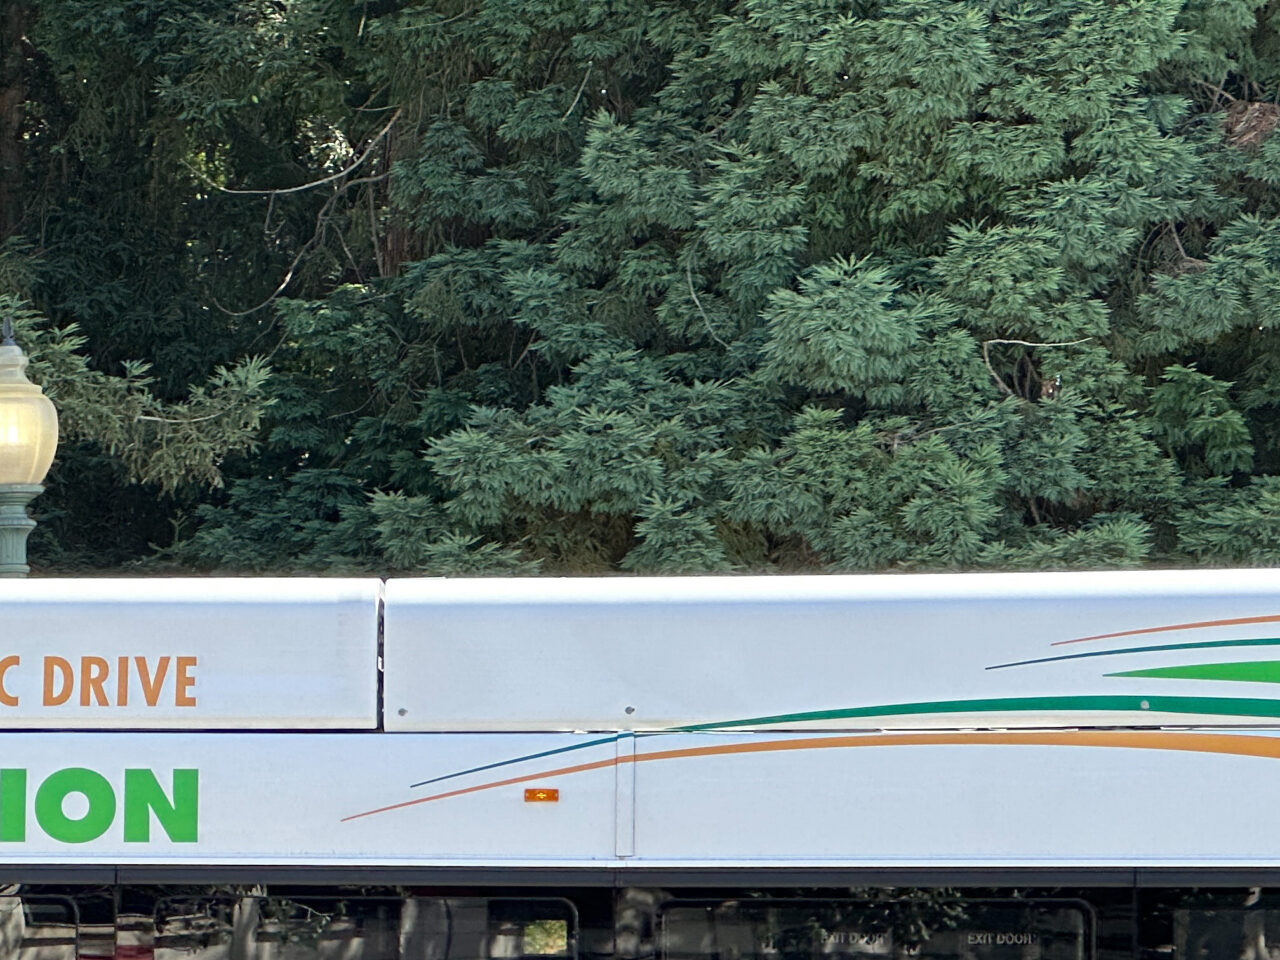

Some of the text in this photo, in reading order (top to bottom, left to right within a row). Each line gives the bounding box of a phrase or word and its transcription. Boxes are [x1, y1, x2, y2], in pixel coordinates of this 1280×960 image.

[43, 656, 197, 707] DRIVE
[968, 933, 1033, 945] EXIT DOOR
